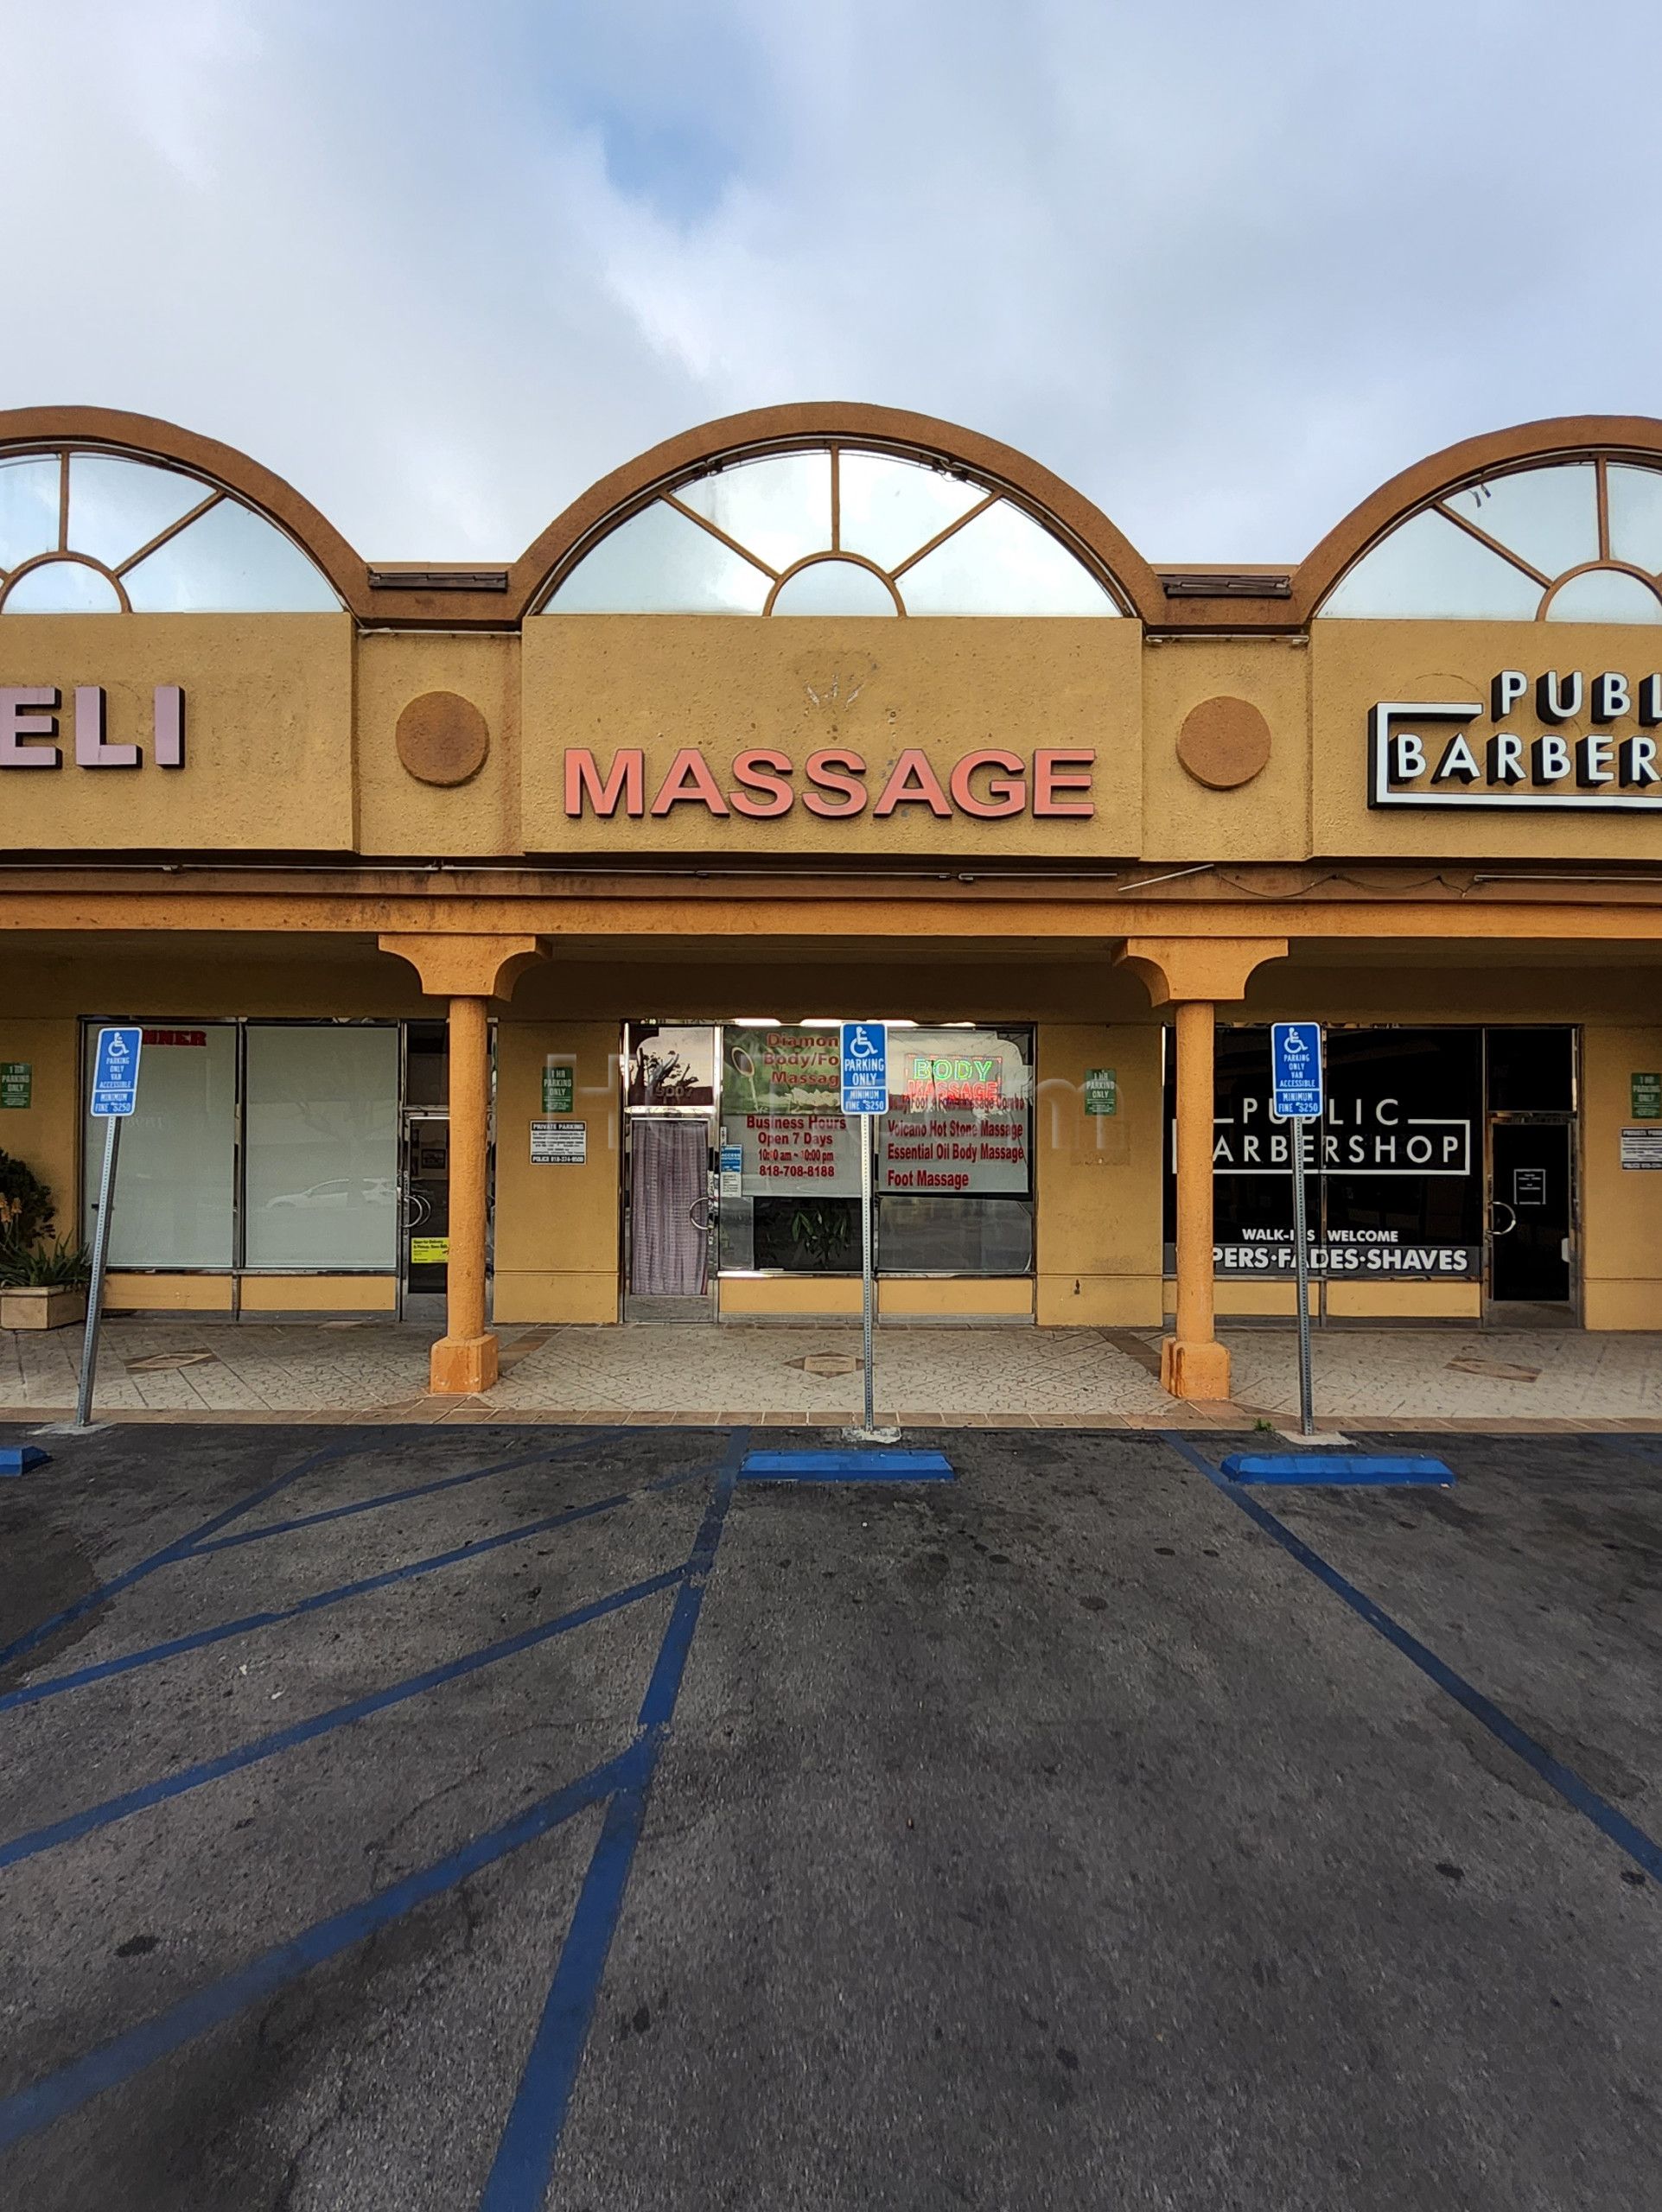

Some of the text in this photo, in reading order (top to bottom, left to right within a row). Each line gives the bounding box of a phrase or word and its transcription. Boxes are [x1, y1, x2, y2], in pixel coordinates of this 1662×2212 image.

[1493, 670, 1662, 723] PUBL
[0, 686, 183, 768] ELI
[1392, 733, 1662, 785] BARBER
[564, 748, 1095, 817] MASSAGE
[844, 1058, 884, 1071] PARKING
[914, 1058, 992, 1081] BODY
[544, 1078, 572, 1087] PARKING
[852, 1072, 877, 1086] ONLY
[1279, 1079, 1315, 1088] ACCESSIBLE
[549, 1088, 566, 1096] ONLY
[849, 1090, 880, 1100] MINIMUM
[1092, 1090, 1110, 1098] ONLY
[1283, 1092, 1313, 1102] MINIMUM
[95, 1103, 108, 1112] FINE
[845, 1101, 861, 1110] FINE
[1243, 1097, 1399, 1126] PULIC
[1278, 1103, 1294, 1113] FINE
[747, 1116, 847, 1129] Business Hours
[888, 1120, 1023, 1141] Volcano Hot Stone Massage
[758, 1132, 833, 1147] Open 7 Days
[780, 1152, 792, 1161] am
[822, 1153, 834, 1164] pm
[888, 1143, 1024, 1164] Essential Oil Body Massage
[759, 1166, 835, 1177] 818-708-8188
[888, 1170, 969, 1190] Foot Massage
[1242, 1229, 1398, 1243] WALK-IS WELCOME
[1366, 1249, 1468, 1271] SHAVES
